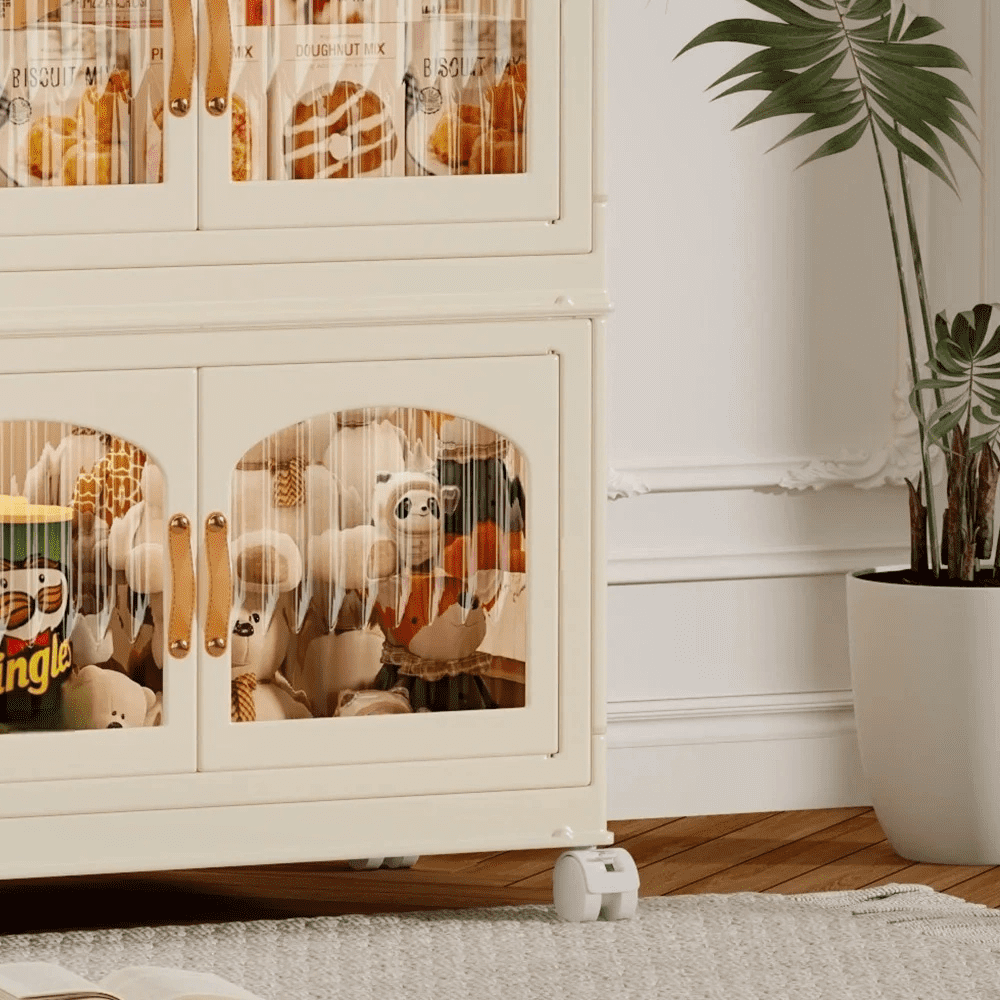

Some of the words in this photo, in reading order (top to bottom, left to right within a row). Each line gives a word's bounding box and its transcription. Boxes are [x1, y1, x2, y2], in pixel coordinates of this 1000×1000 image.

[296, 43, 360, 57] DOUGHNUT
[364, 42, 385, 56] MIX
[12, 66, 77, 89] BISCUIT
